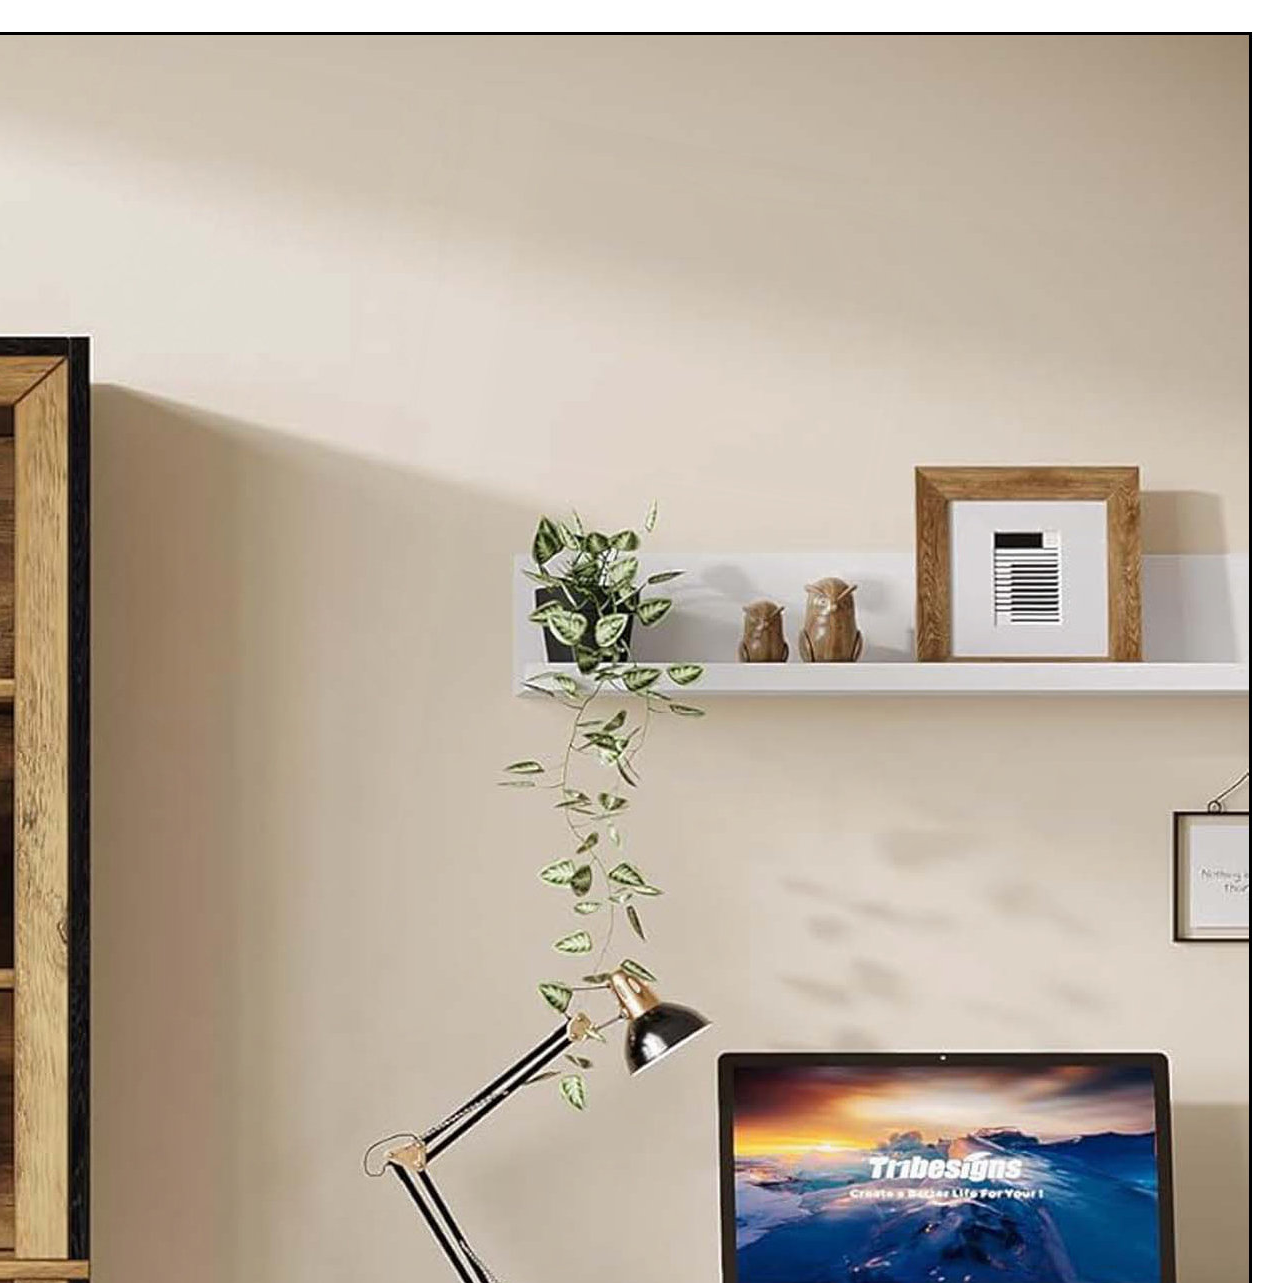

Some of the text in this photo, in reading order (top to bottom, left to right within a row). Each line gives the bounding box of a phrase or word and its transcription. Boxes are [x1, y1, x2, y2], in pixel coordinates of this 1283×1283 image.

[869, 1152, 1023, 1182] Tribesigns
[849, 1188, 894, 1199] Create
[907, 1187, 949, 1199] Better
[952, 1188, 977, 1199] Life
[979, 1188, 1003, 1199] For
